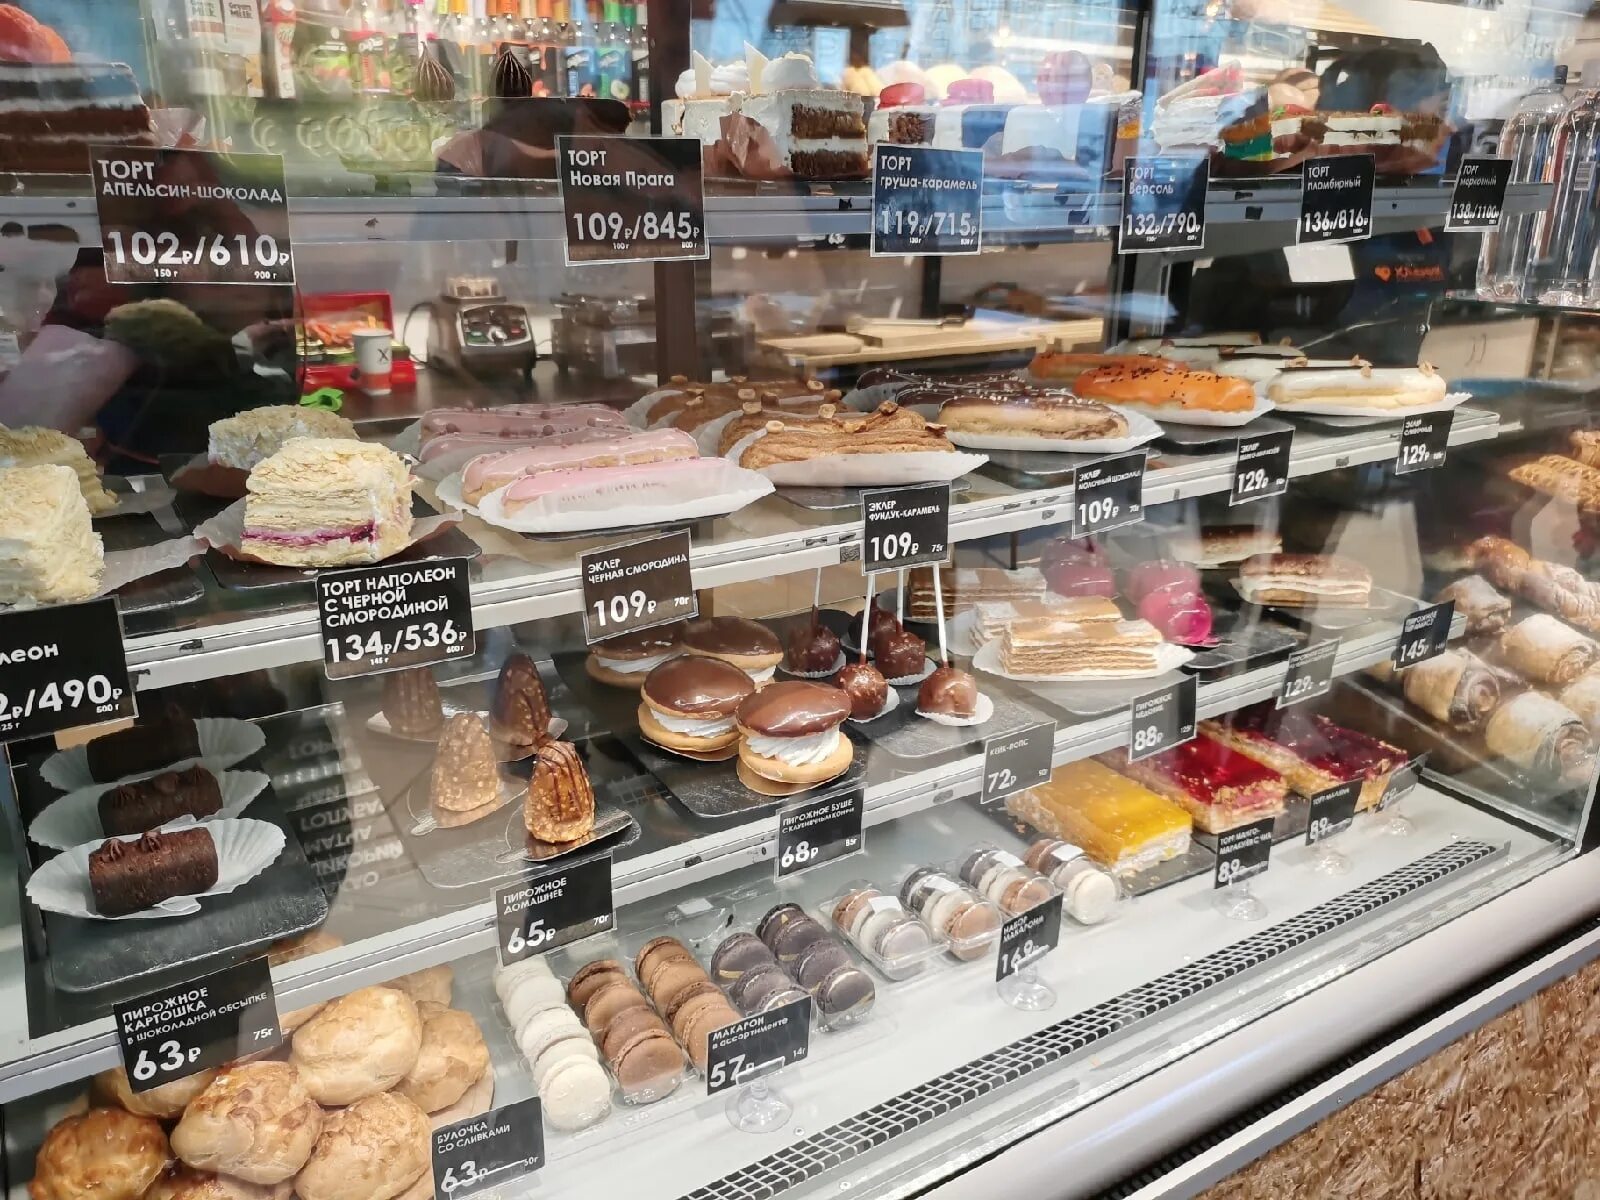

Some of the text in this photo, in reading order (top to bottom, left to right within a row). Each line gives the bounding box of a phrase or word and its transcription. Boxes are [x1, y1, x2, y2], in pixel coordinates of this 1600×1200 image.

[567, 149, 607, 167] ТОРТ
[880, 155, 912, 171] ТОРТ
[97, 159, 154, 180] ТОРТ
[569, 170, 675, 190] Новая Прага
[1129, 166, 1155, 180] ТОРТ
[1307, 165, 1330, 179] ТОРТ
[1463, 164, 1480, 176] ТОРТ
[102, 181, 283, 203] АПЕЛЬСИН-ШОКОЛАД
[880, 176, 978, 191] груша-карамель
[1128, 181, 1174, 197] Версаль
[1078, 469, 1102, 482] ЭКЛЕР
[868, 500, 897, 512] ЭКЛЕР
[868, 504, 941, 522] ФУНДУК-КАРАМЕЛЬ
[587, 558, 621, 574] ЭКЛЕР
[588, 553, 688, 584] ЧЕРНАЯ СМОРОДИНА
[321, 566, 456, 597] ТОРТ НАПОЛЕОН
[324, 586, 407, 613] С ЧЕРНОЙ
[325, 594, 449, 628] СМОРОДИНОЙ
[782, 798, 854, 827] ПИРОЖНОЕ БУШЕ
[503, 876, 568, 905] ПИРОЖНОЕ
[503, 888, 564, 916] ДОМАШНЕЕ
[121, 986, 209, 1023] ПИРОЖНОЕ
[124, 1000, 207, 1034] КАРТОШКА
[136, 1009, 217, 1042] ШОКОЛАДНОЙ
[218, 991, 268, 1014] ОБСЫПКЕ
[712, 1015, 765, 1041] МАКАРОН
[437, 1121, 489, 1144] БУЛОЧКА
[437, 1124, 511, 1154] СО СЛИВКАМИ
